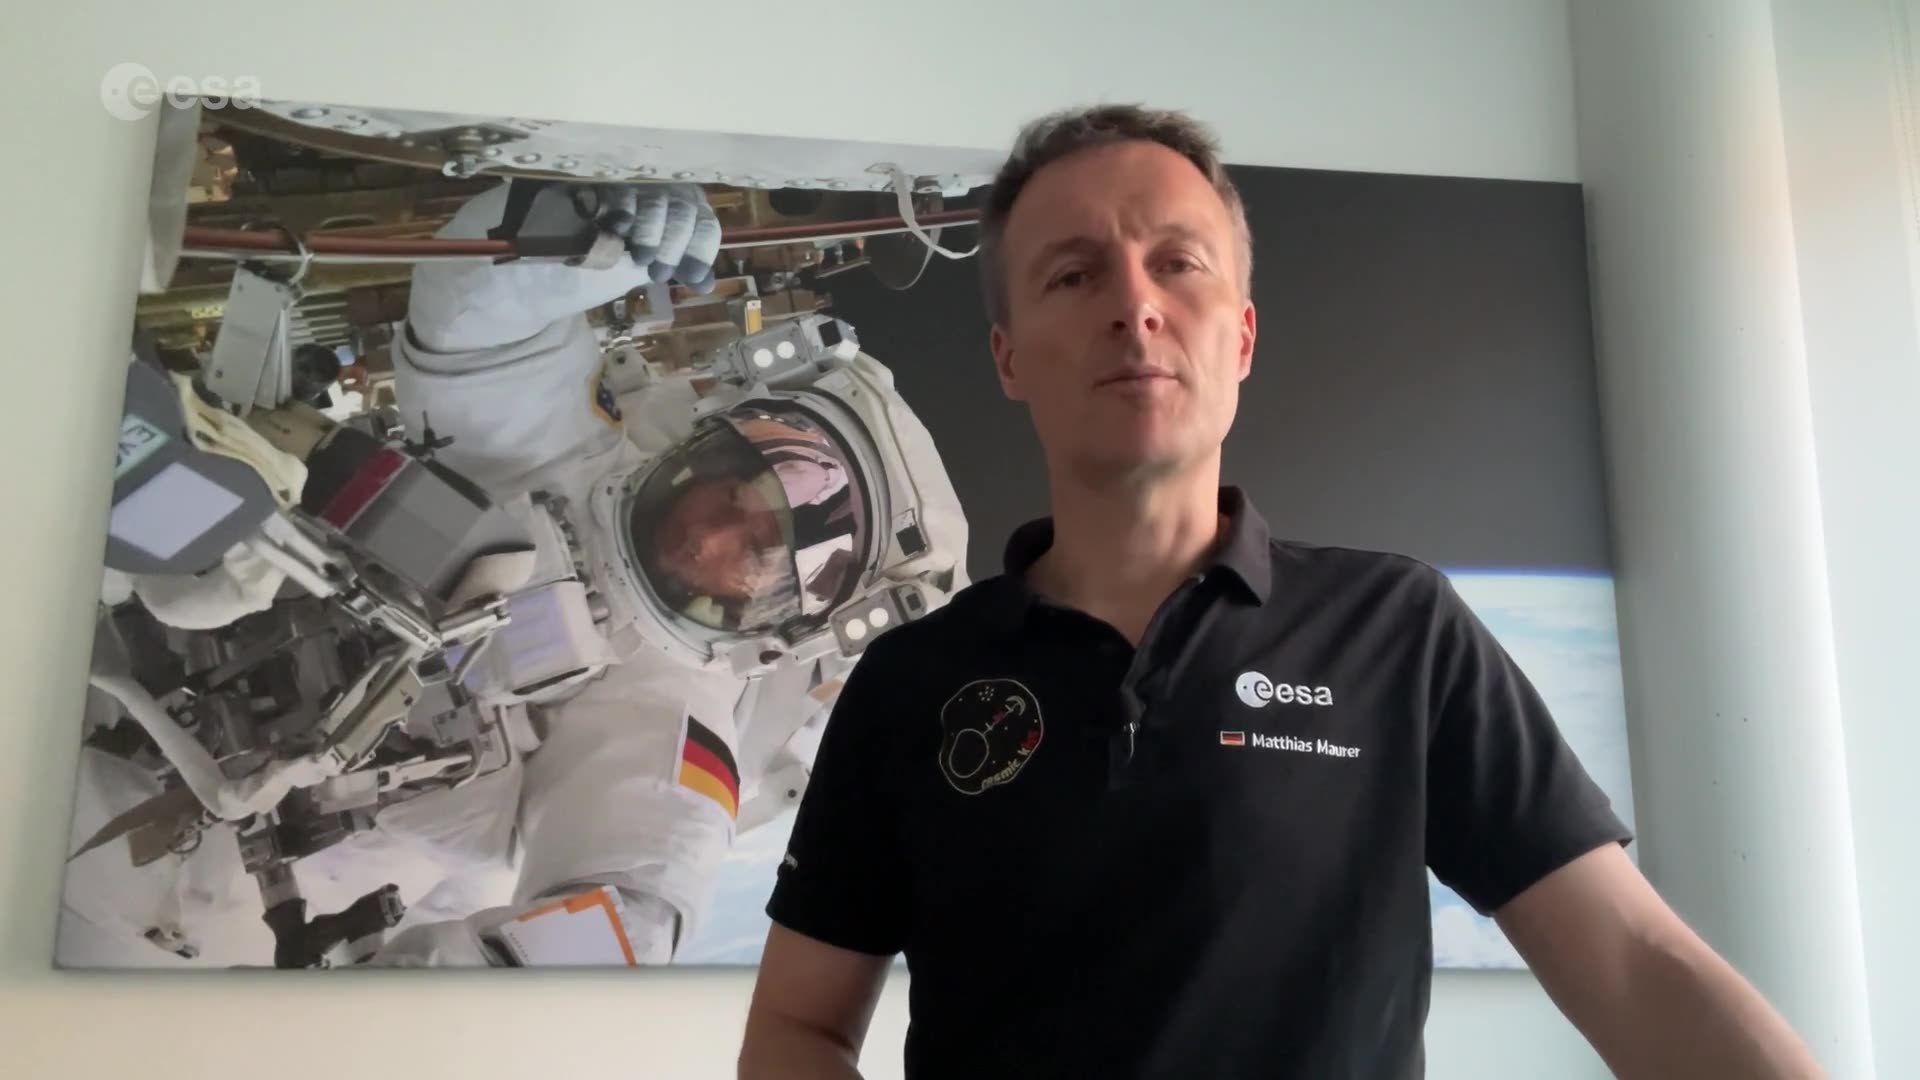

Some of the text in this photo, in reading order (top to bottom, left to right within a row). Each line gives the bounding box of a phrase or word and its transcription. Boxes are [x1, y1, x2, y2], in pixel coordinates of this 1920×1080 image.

[1275, 683, 1334, 706] esa
[1252, 732, 1361, 758] Matthias Maurer
